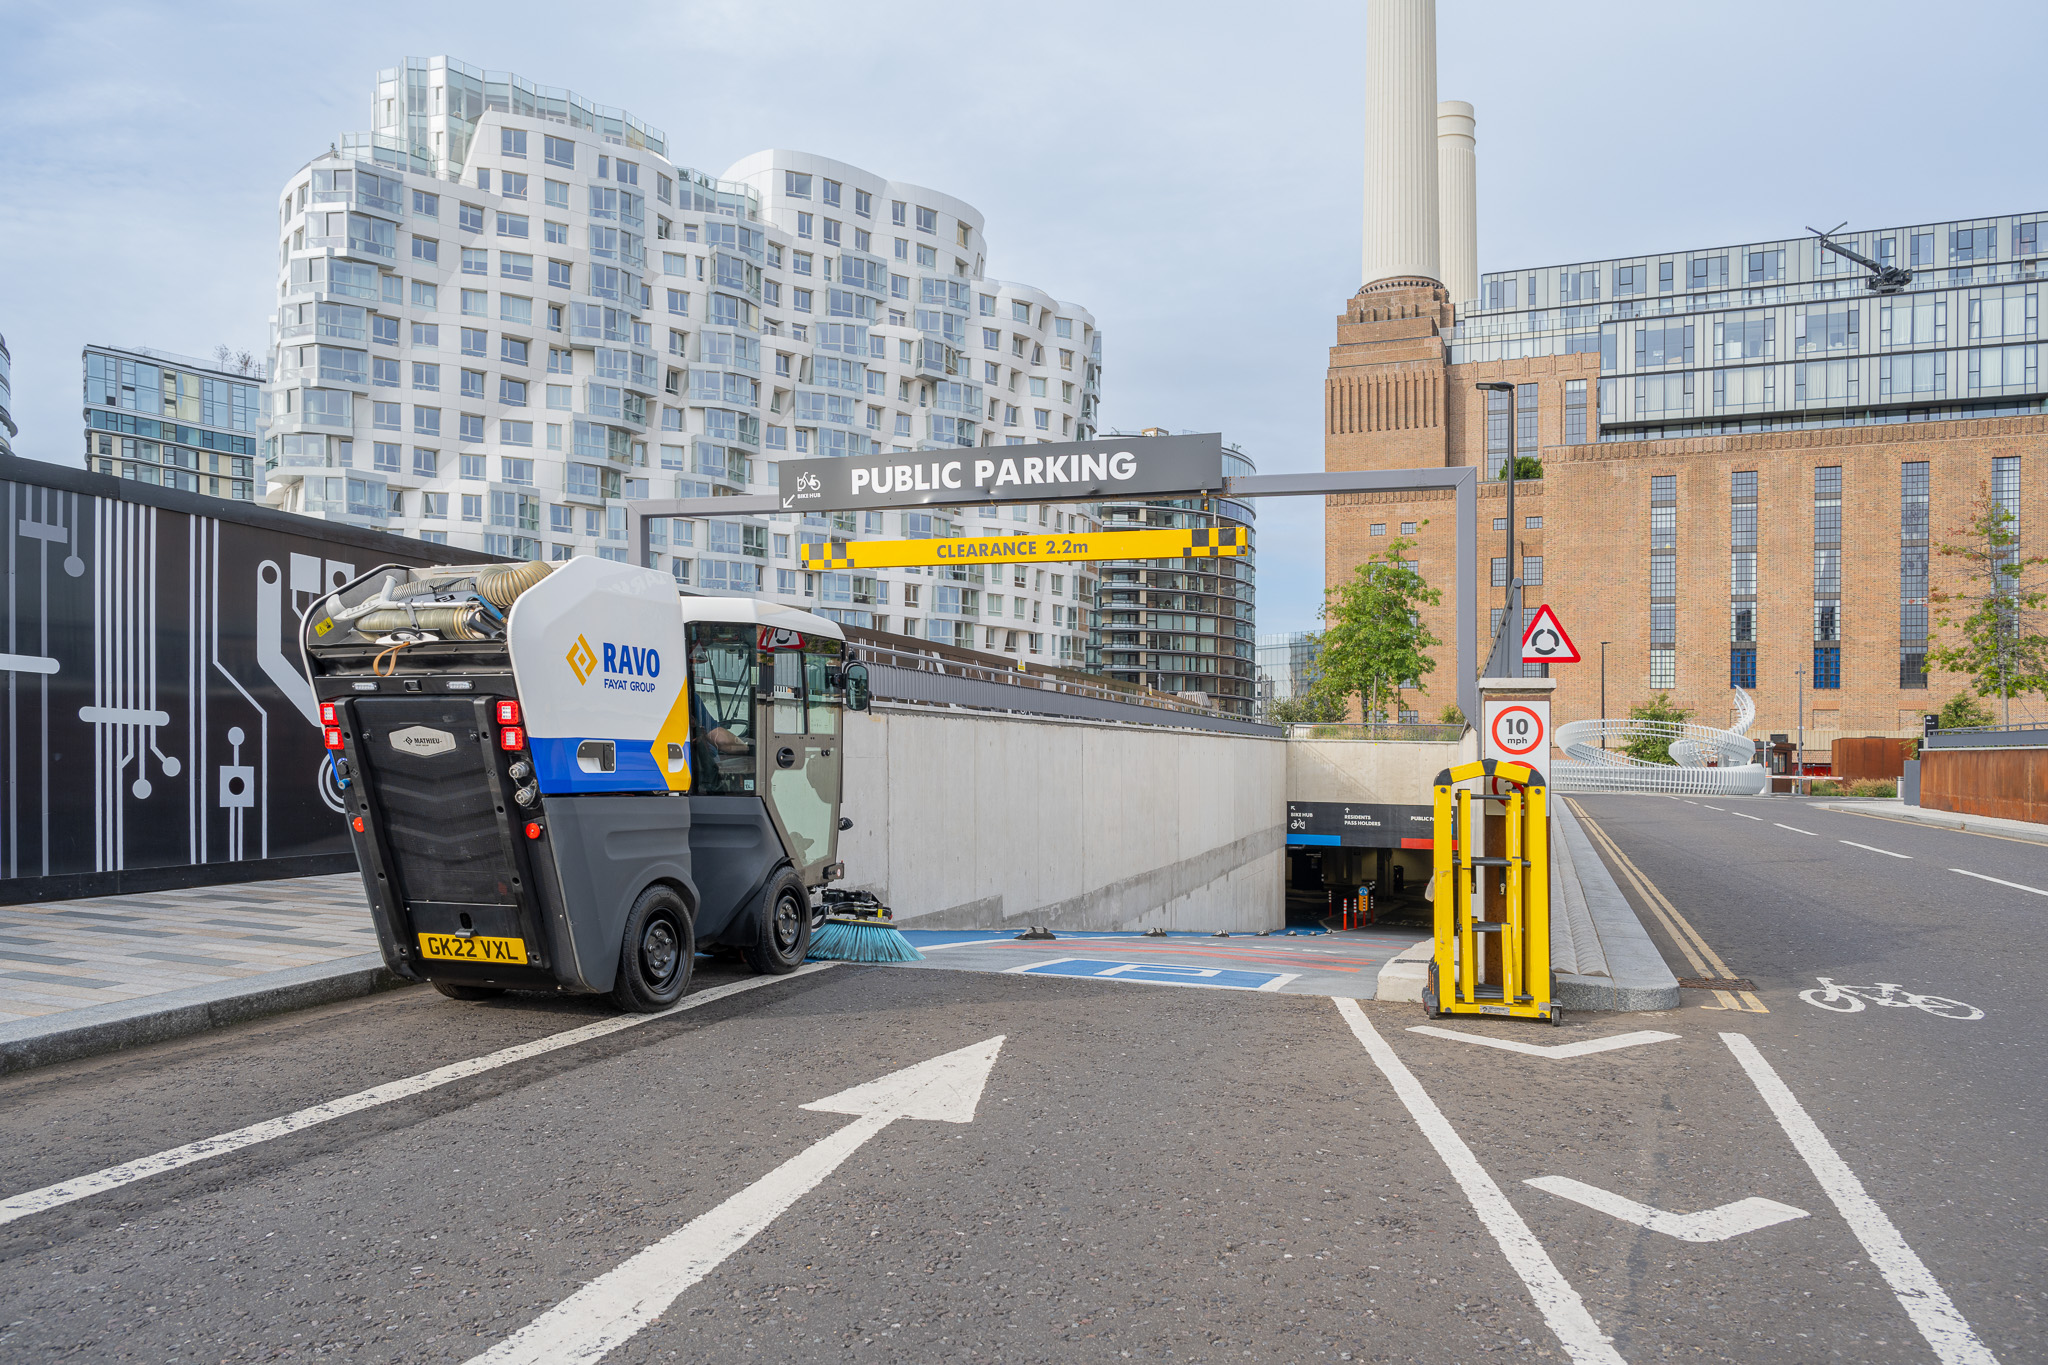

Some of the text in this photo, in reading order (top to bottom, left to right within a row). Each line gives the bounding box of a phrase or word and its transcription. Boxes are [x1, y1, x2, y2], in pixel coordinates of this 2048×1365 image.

[851, 451, 1137, 496] PUBLIC PARKING
[936, 539, 1089, 559] CLEARANCE 2.2m
[603, 642, 660, 678] RAVO
[604, 678, 656, 693] FAYAT GROUP
[1505, 718, 1529, 735] 10
[413, 737, 440, 745] MATHIEU
[1507, 737, 1528, 746] mph
[427, 936, 519, 961] GK22 VXL
